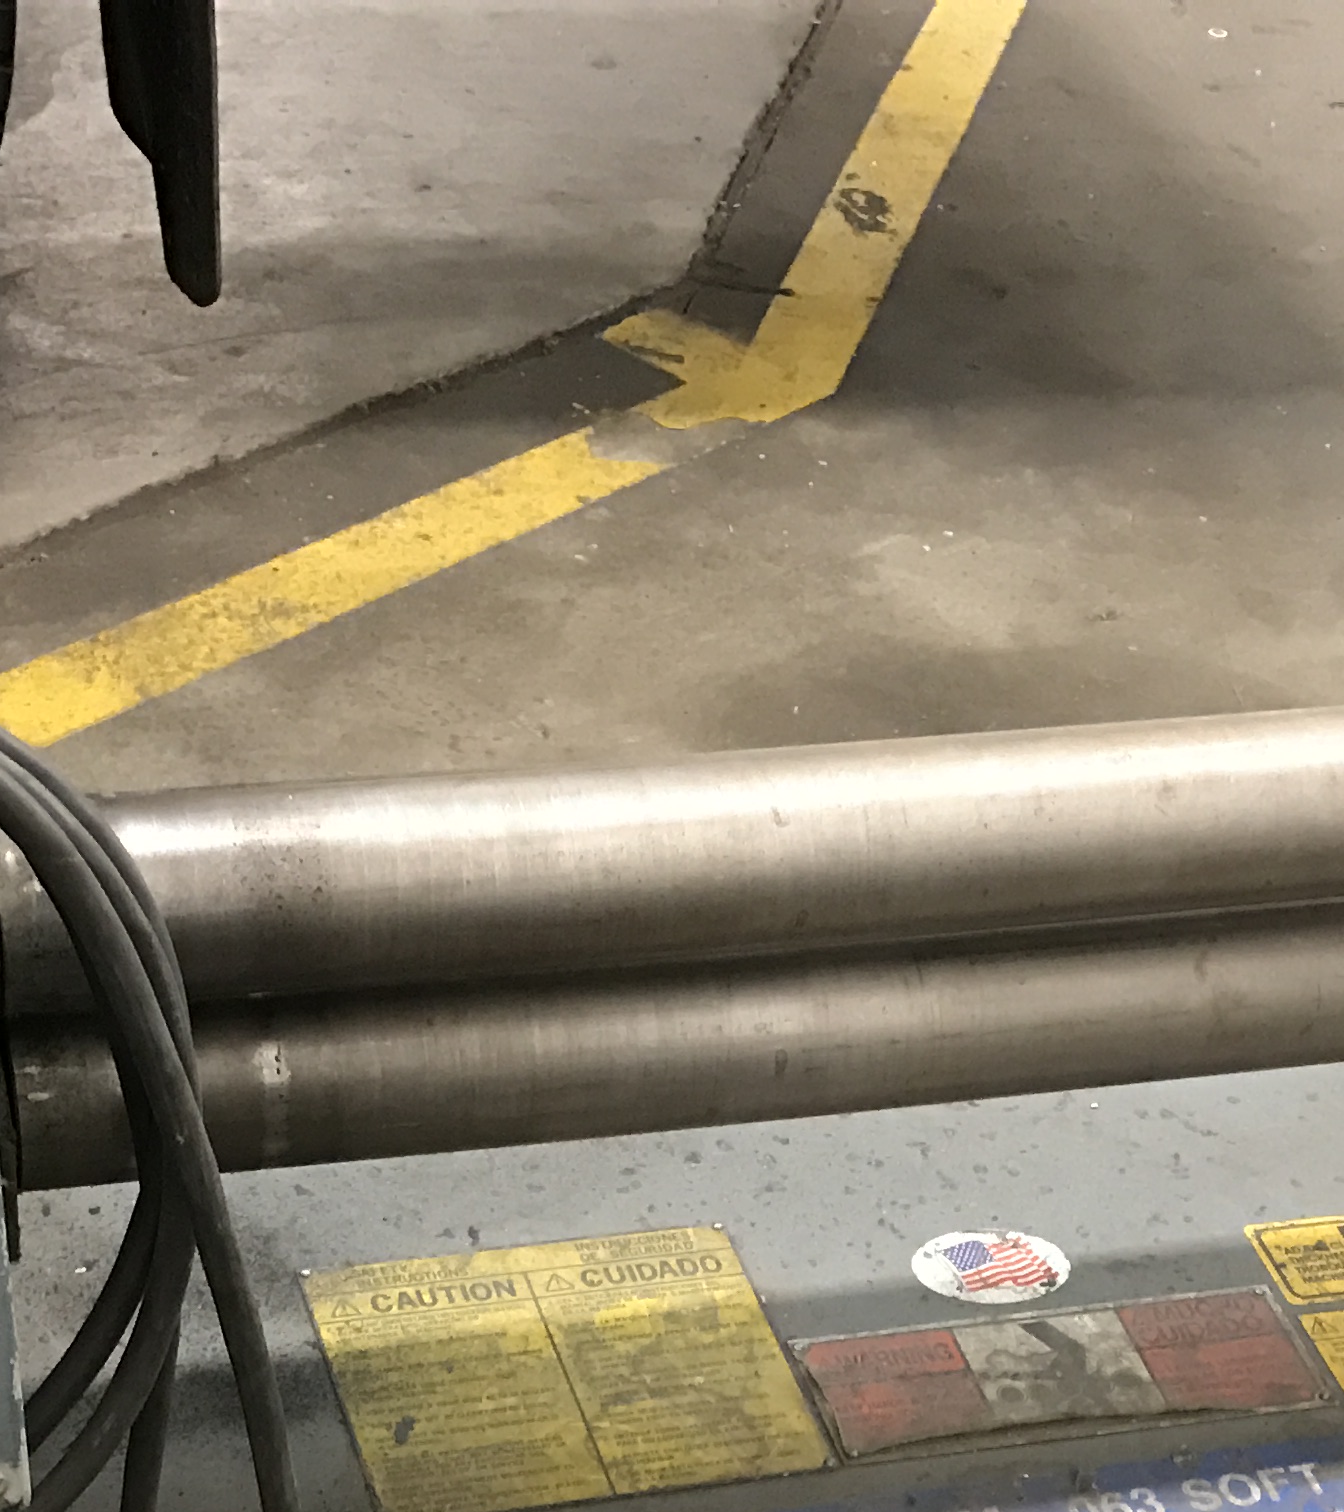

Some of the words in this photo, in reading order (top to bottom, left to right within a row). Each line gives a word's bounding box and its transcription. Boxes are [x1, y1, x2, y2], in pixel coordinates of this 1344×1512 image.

[580, 1255, 723, 1288] CUIDADO
[370, 1279, 517, 1314] CAUTION
[1182, 1462, 1323, 1512] SOFT
